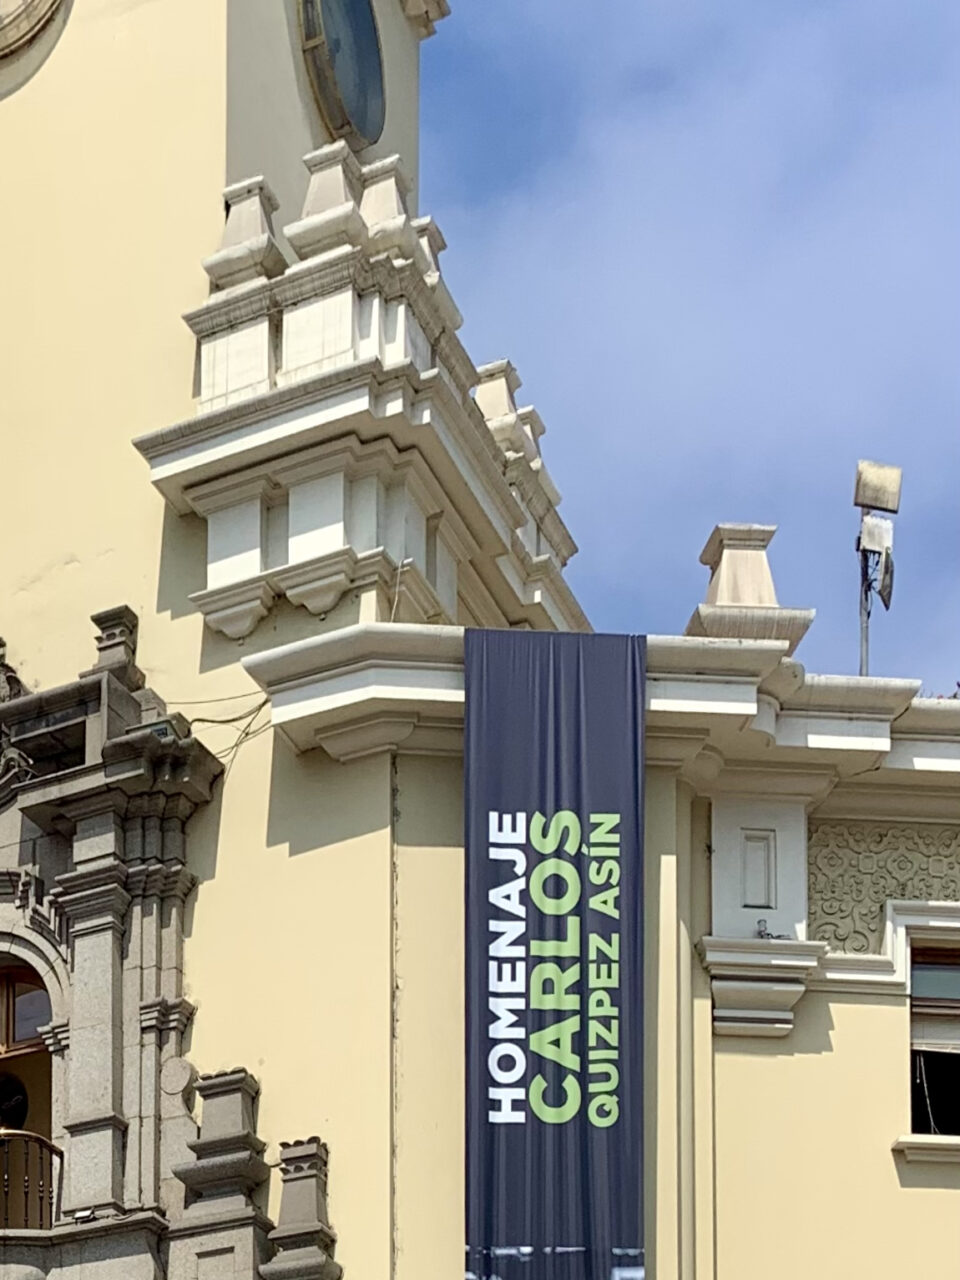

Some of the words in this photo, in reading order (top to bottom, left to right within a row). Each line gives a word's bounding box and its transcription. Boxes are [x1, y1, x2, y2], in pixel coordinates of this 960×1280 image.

[488, 811, 527, 1123] HOMENAJE
[529, 809, 582, 1125] CARLOS
[581, 812, 621, 920] ASÍN
[587, 932, 620, 1128] QUIZPEZ
